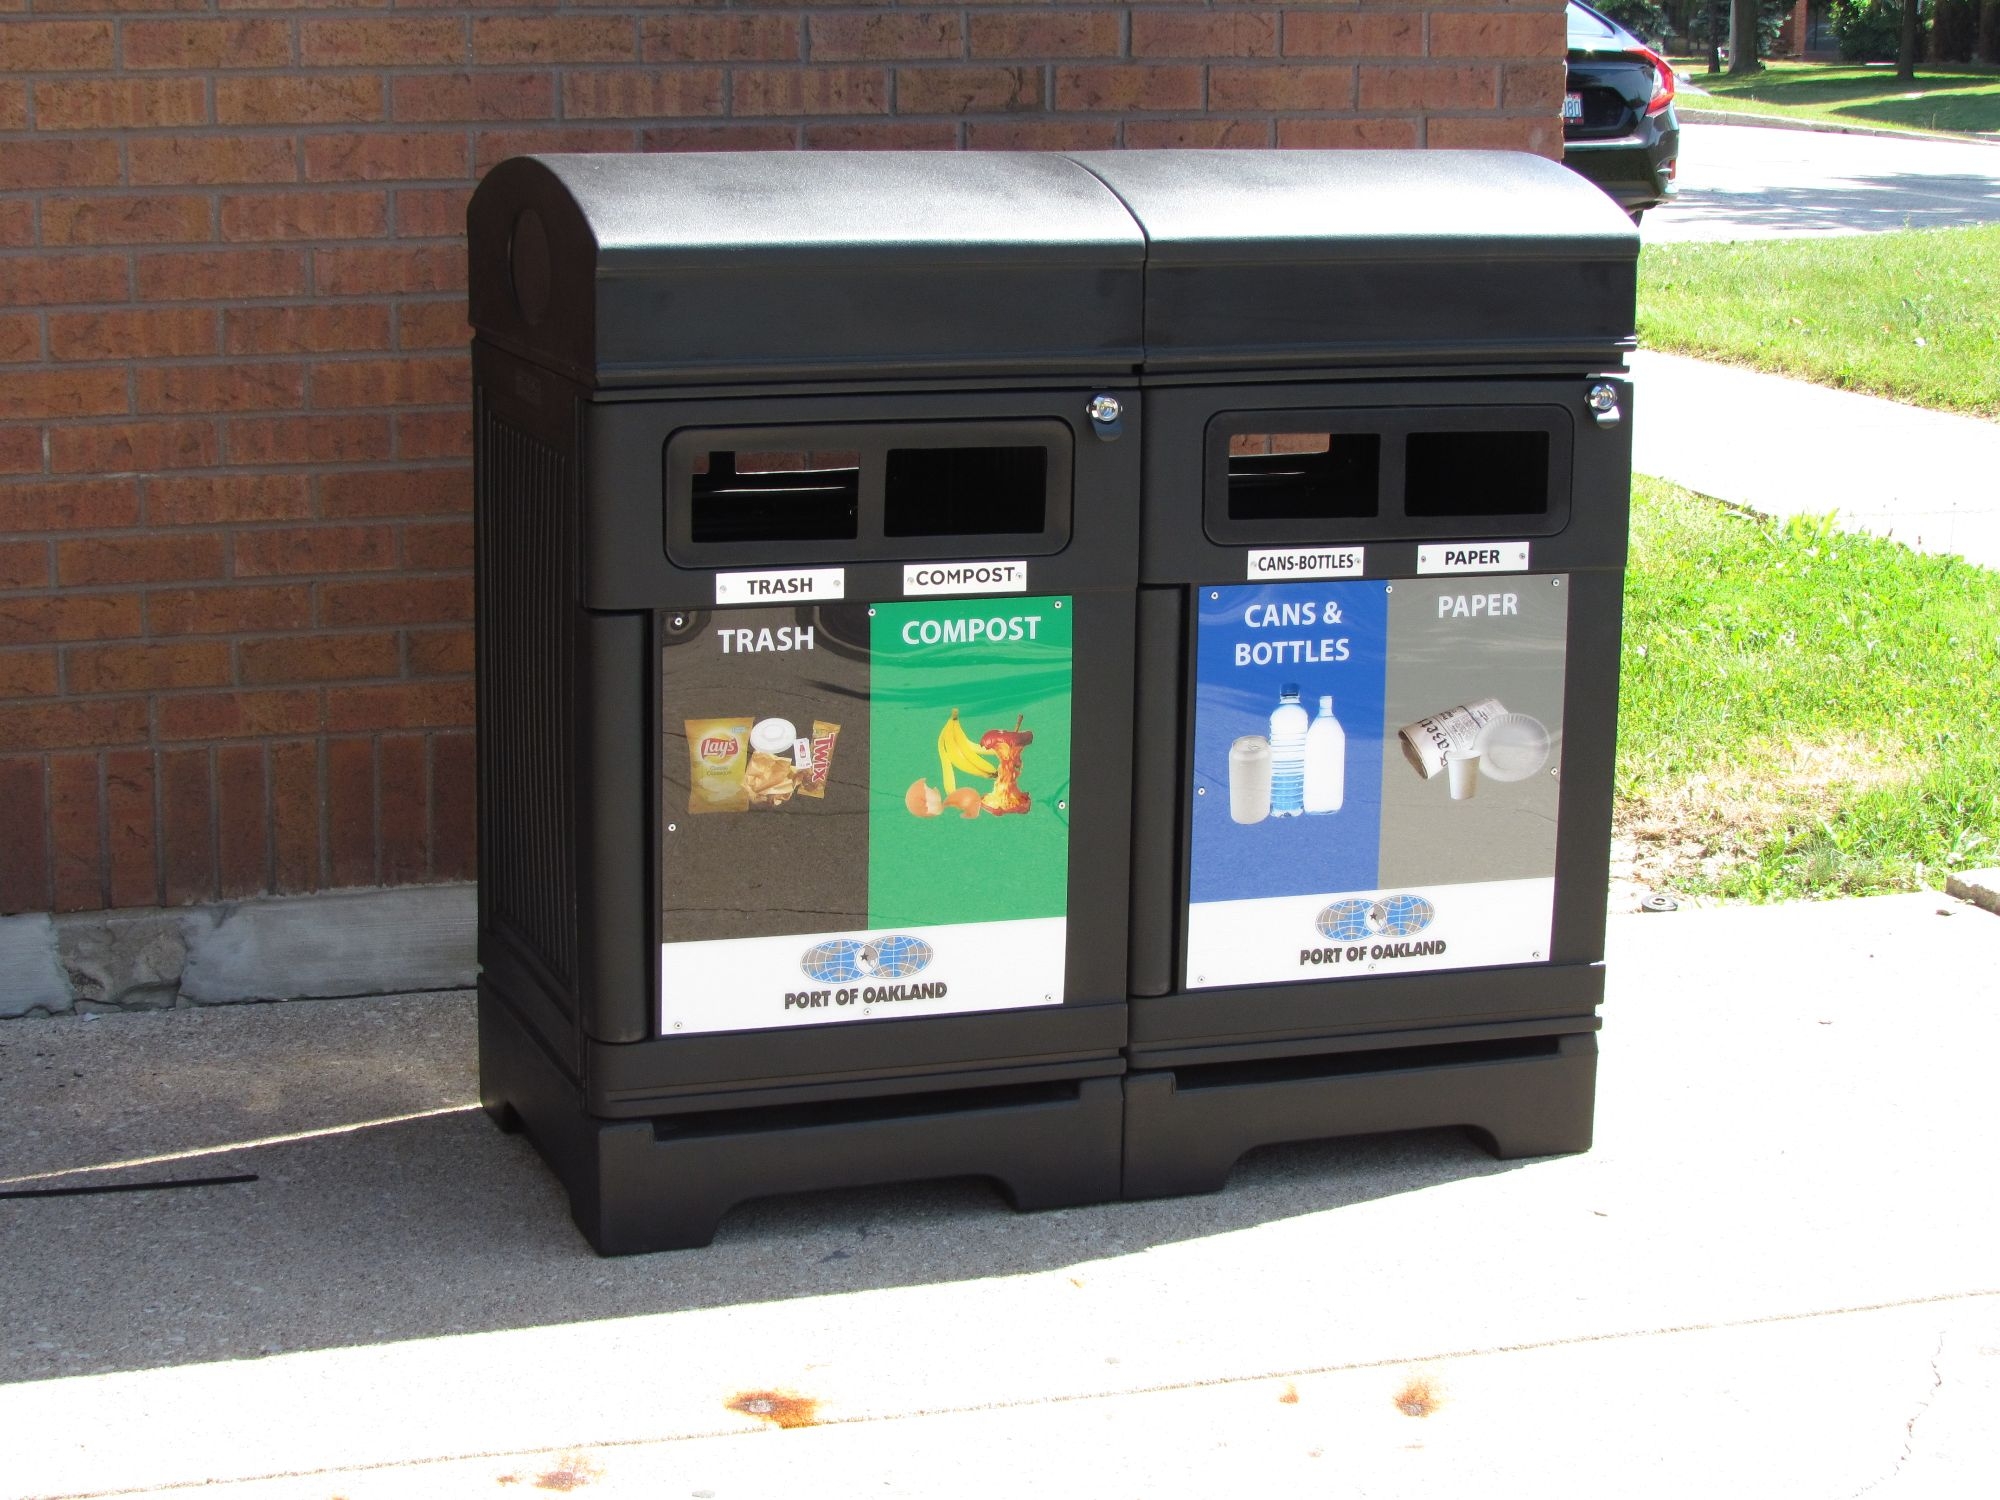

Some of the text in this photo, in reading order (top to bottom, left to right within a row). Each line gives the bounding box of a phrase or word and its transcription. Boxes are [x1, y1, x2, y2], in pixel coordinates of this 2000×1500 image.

[1258, 554, 1354, 571] CANS-BOTTLES
[1444, 549, 1500, 565] PAPER
[747, 577, 813, 595] TRASH
[916, 566, 1015, 586] COMPOST
[1244, 601, 1342, 628] CANS &
[1438, 593, 1518, 618] PAPER
[718, 626, 814, 654] TRASH
[902, 616, 1042, 646] COMPOST
[1235, 638, 1350, 666] BOTTLES
[1300, 940, 1446, 966] PORT OF OAKLAND
[784, 982, 948, 1009] PORT OF OAKLAND
